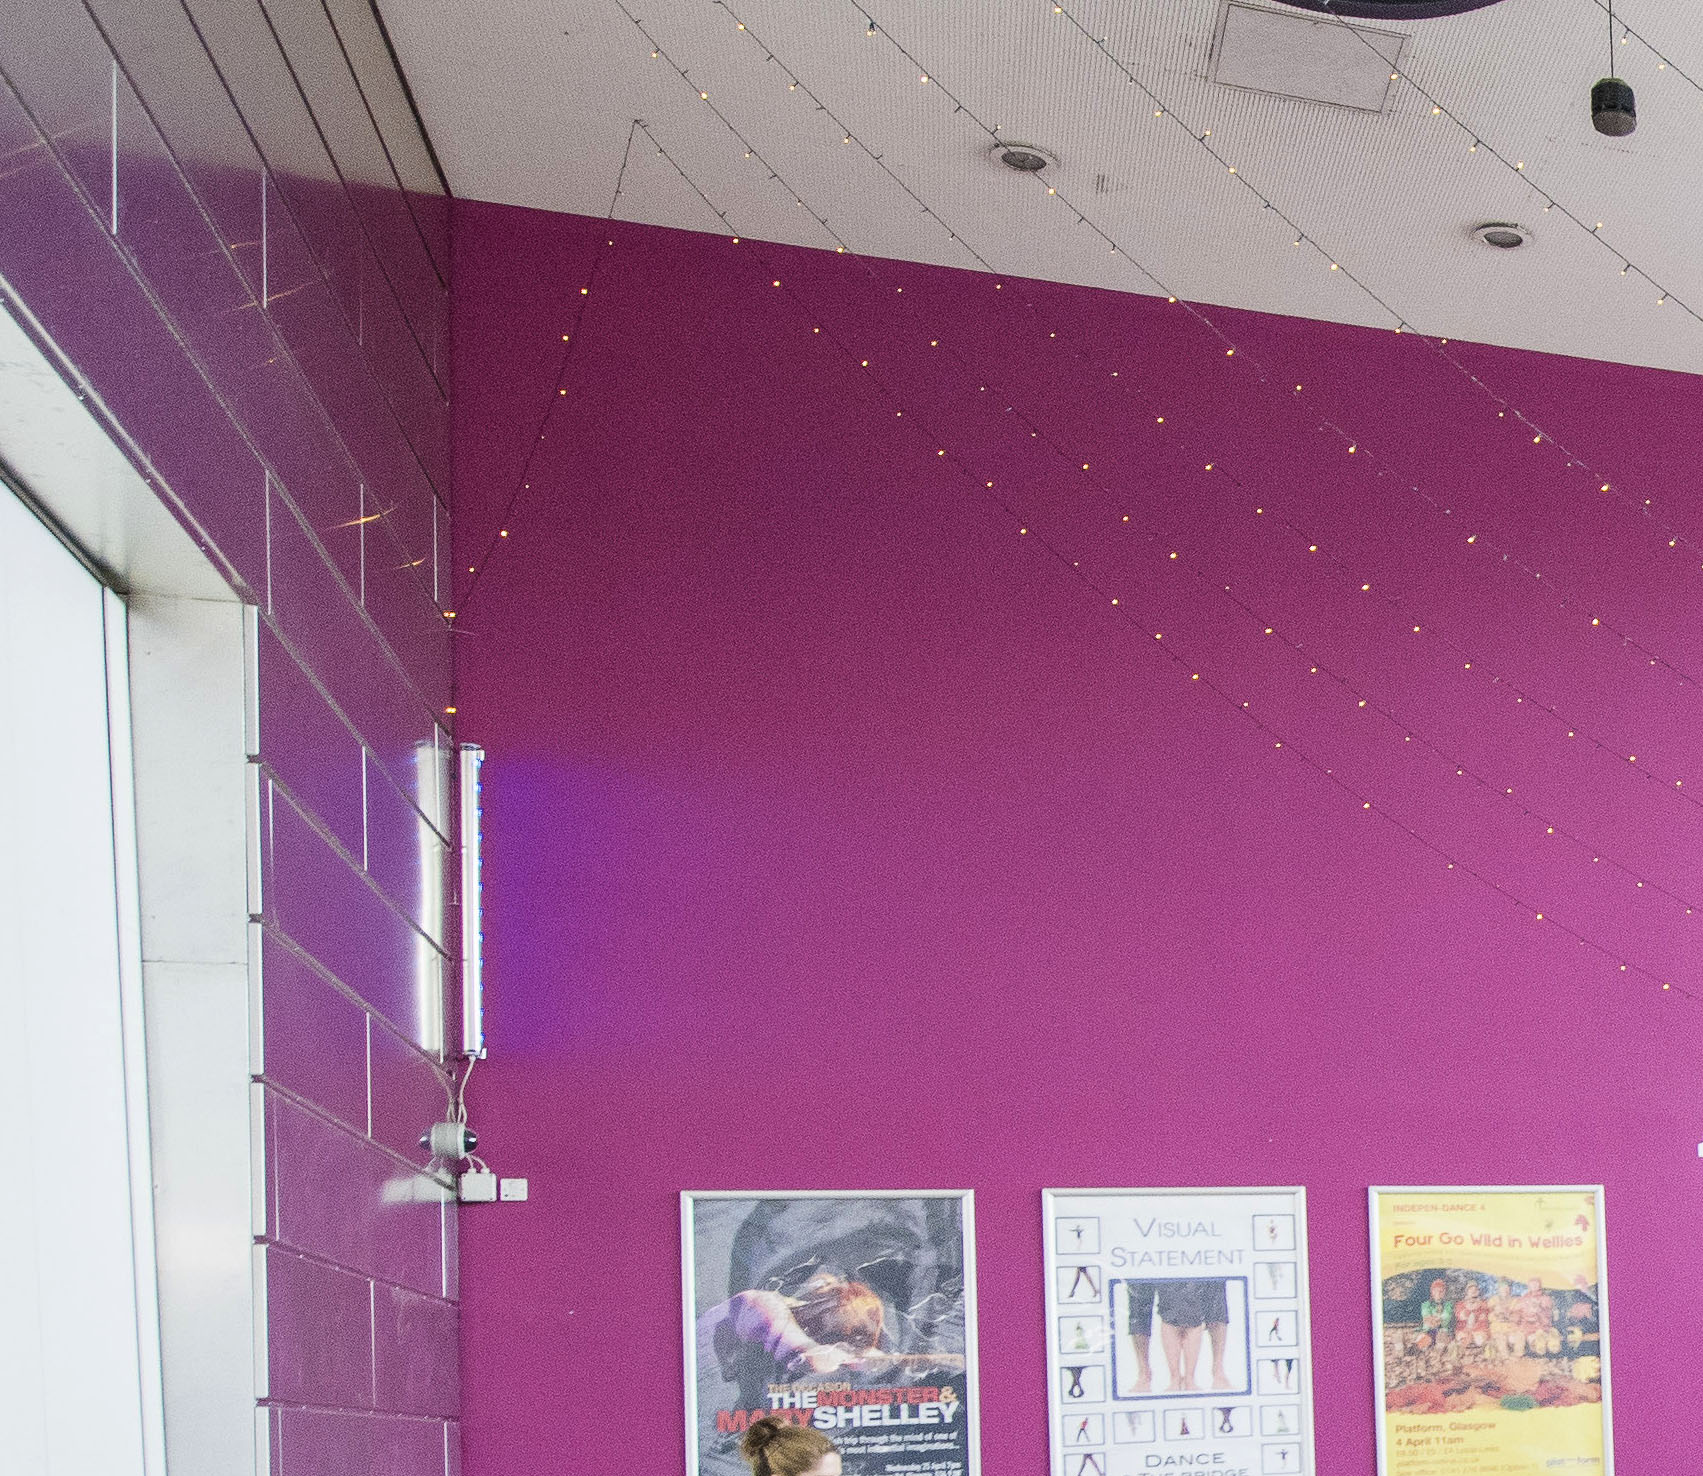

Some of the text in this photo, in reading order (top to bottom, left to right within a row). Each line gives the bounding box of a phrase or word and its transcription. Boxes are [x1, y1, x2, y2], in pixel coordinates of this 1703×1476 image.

[1134, 1218, 1222, 1238] VISUAL
[1394, 1232, 1582, 1249] Four Go Wild in Wellies
[1111, 1246, 1246, 1268] STATEMENT
[814, 1401, 959, 1430] SHELLEY
[1396, 1421, 1496, 1434] Platform, Glasgow
[1406, 1437, 1432, 1448] April
[1145, 1452, 1225, 1468] DANCE
